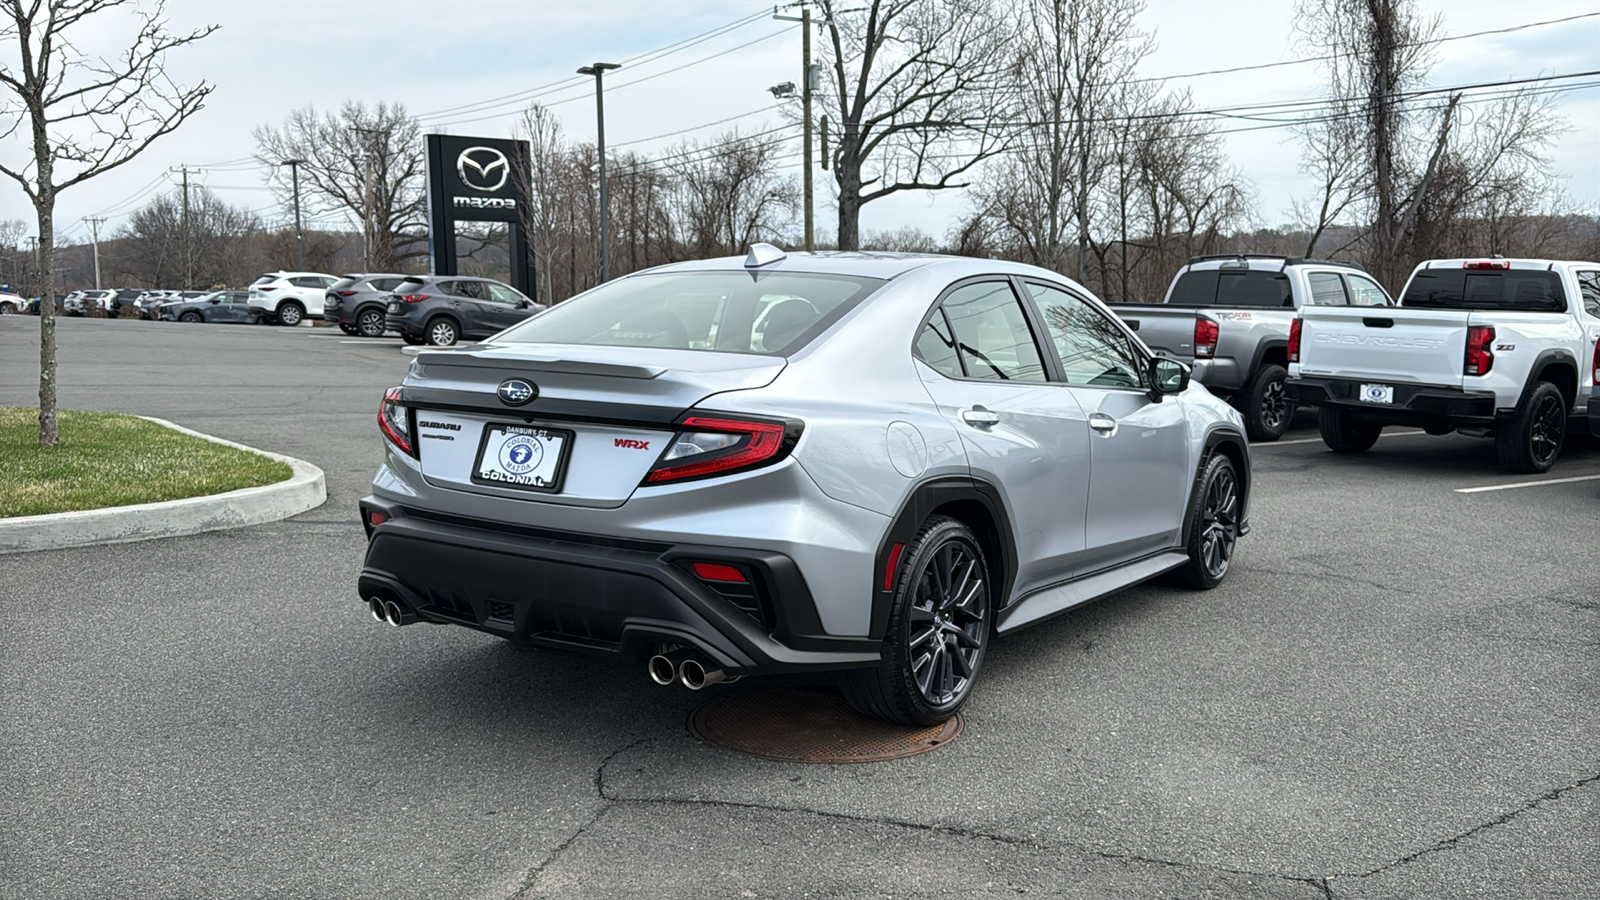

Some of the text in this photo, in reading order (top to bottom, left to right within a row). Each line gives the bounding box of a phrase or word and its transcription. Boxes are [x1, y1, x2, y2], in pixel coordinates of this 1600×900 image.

[453, 196, 516, 209] mazda
[1314, 333, 1445, 349] CHEVROLET
[418, 420, 462, 432] SUBARU
[538, 430, 548, 438] CT
[506, 437, 539, 453] COLONIAL
[614, 438, 650, 450] WRX
[506, 461, 531, 472] MAZDA
[481, 471, 545, 487] COLONIAL
